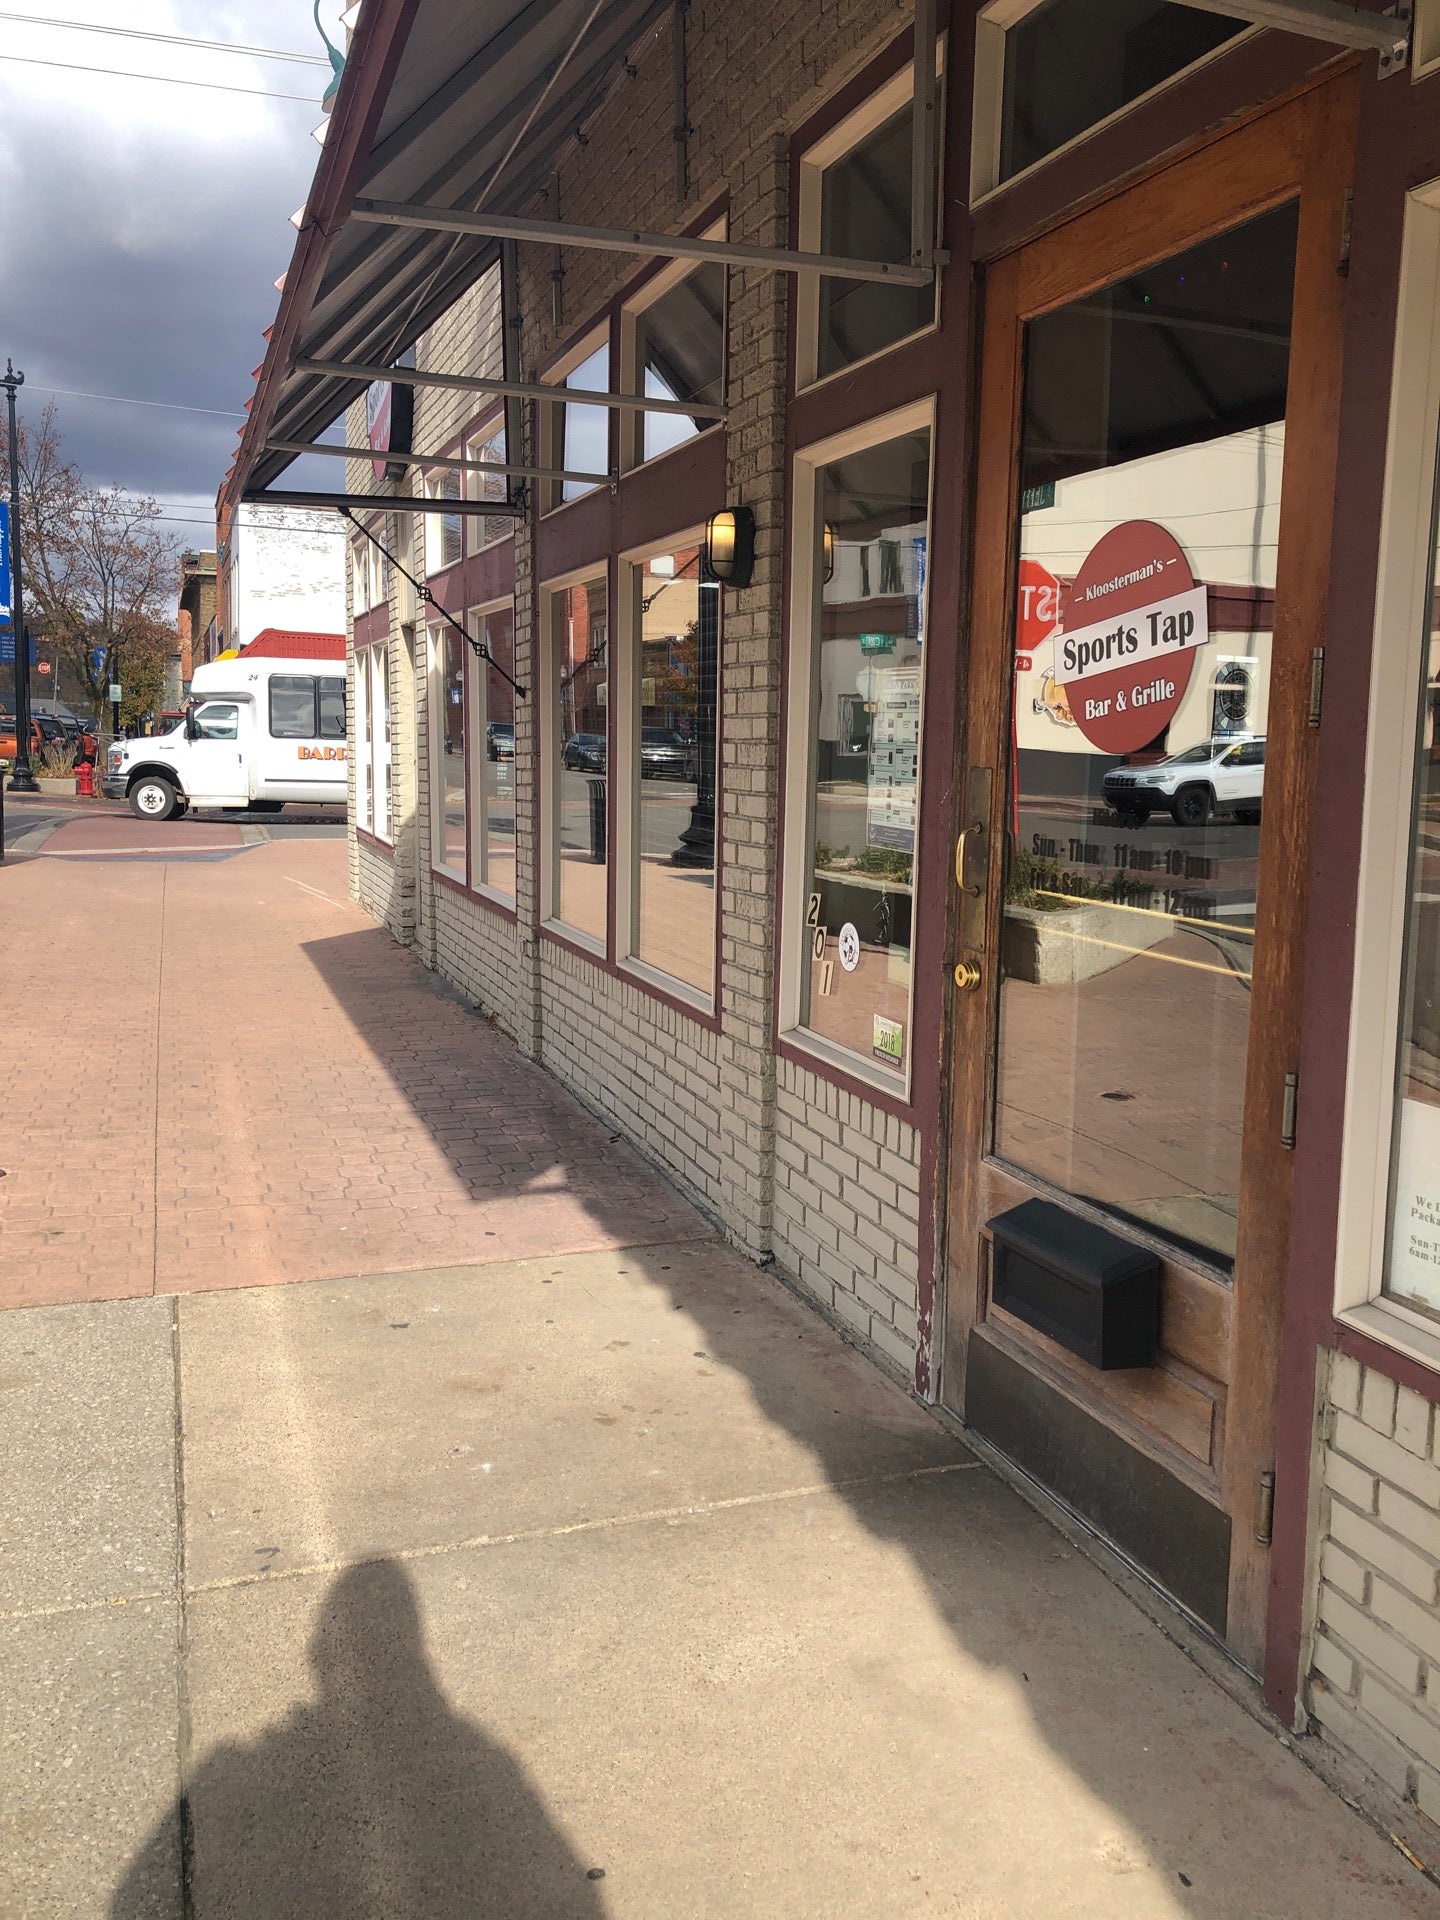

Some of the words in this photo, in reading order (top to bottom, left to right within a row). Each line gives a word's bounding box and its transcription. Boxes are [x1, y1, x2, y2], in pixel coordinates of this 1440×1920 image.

[1085, 559, 1164, 602] Kloosterman's
[1063, 624, 1139, 675] Sports
[1145, 609, 1195, 647] Tap
[1085, 698, 1112, 720] Bar
[1115, 690, 1127, 713] &
[1131, 678, 1176, 708] Grille
[879, 1029, 896, 1052] 2018
[1415, 1195, 1433, 1210] We
